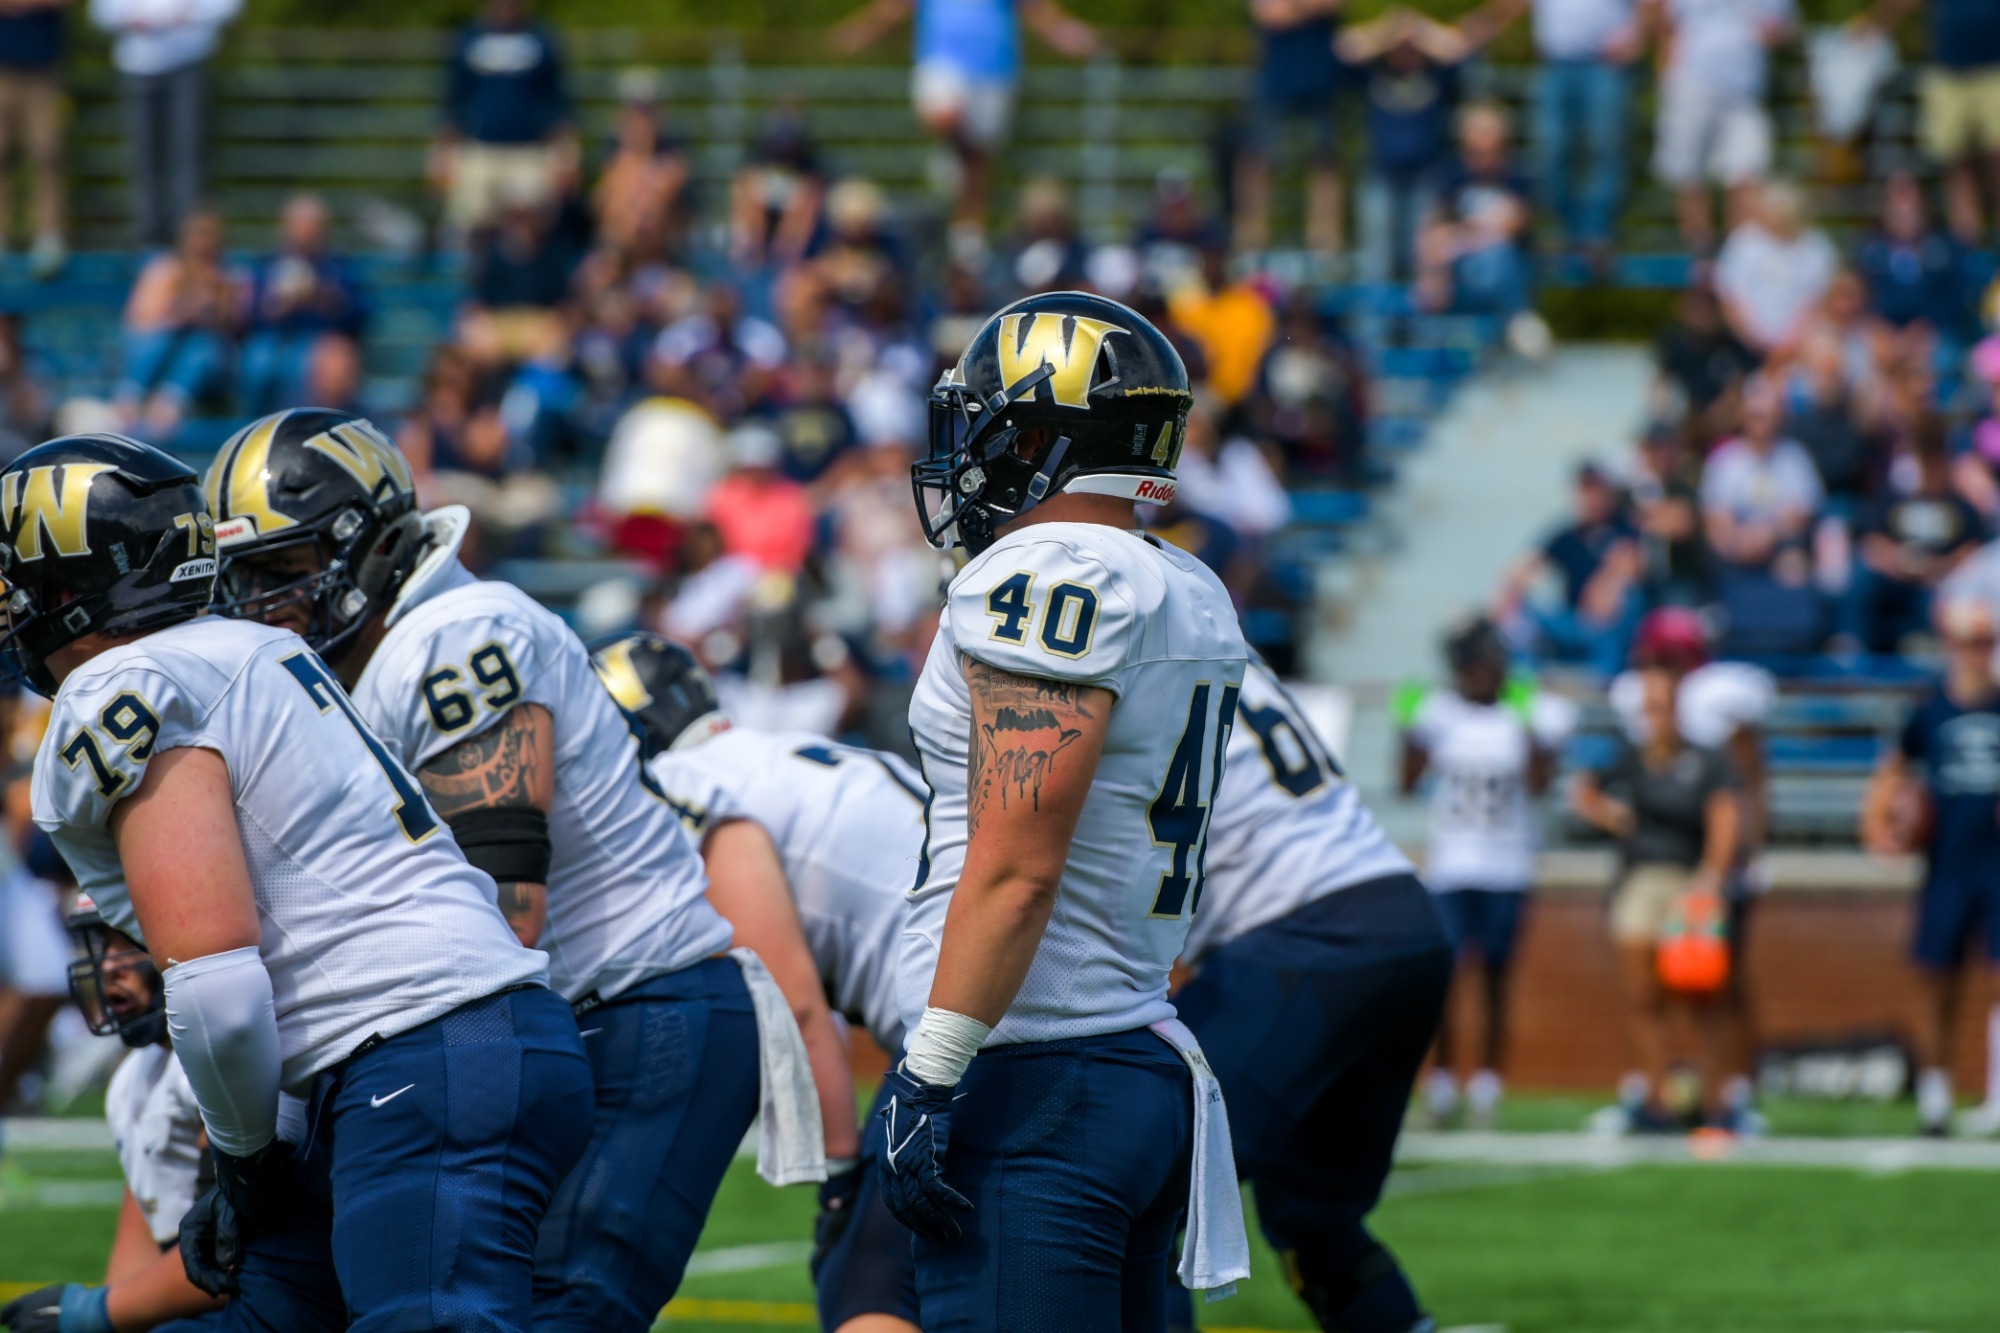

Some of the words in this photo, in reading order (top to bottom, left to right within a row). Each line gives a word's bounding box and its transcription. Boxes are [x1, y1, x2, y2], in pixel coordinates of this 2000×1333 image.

[998, 312, 1131, 410] W
[302, 418, 413, 505] W
[1, 463, 119, 563] W
[173, 511, 215, 557] 79
[178, 561, 215, 578] XENITH
[985, 569, 1101, 661] 40
[419, 639, 525, 737] 69
[57, 690, 162, 800] 79
[276, 649, 441, 846] 7
